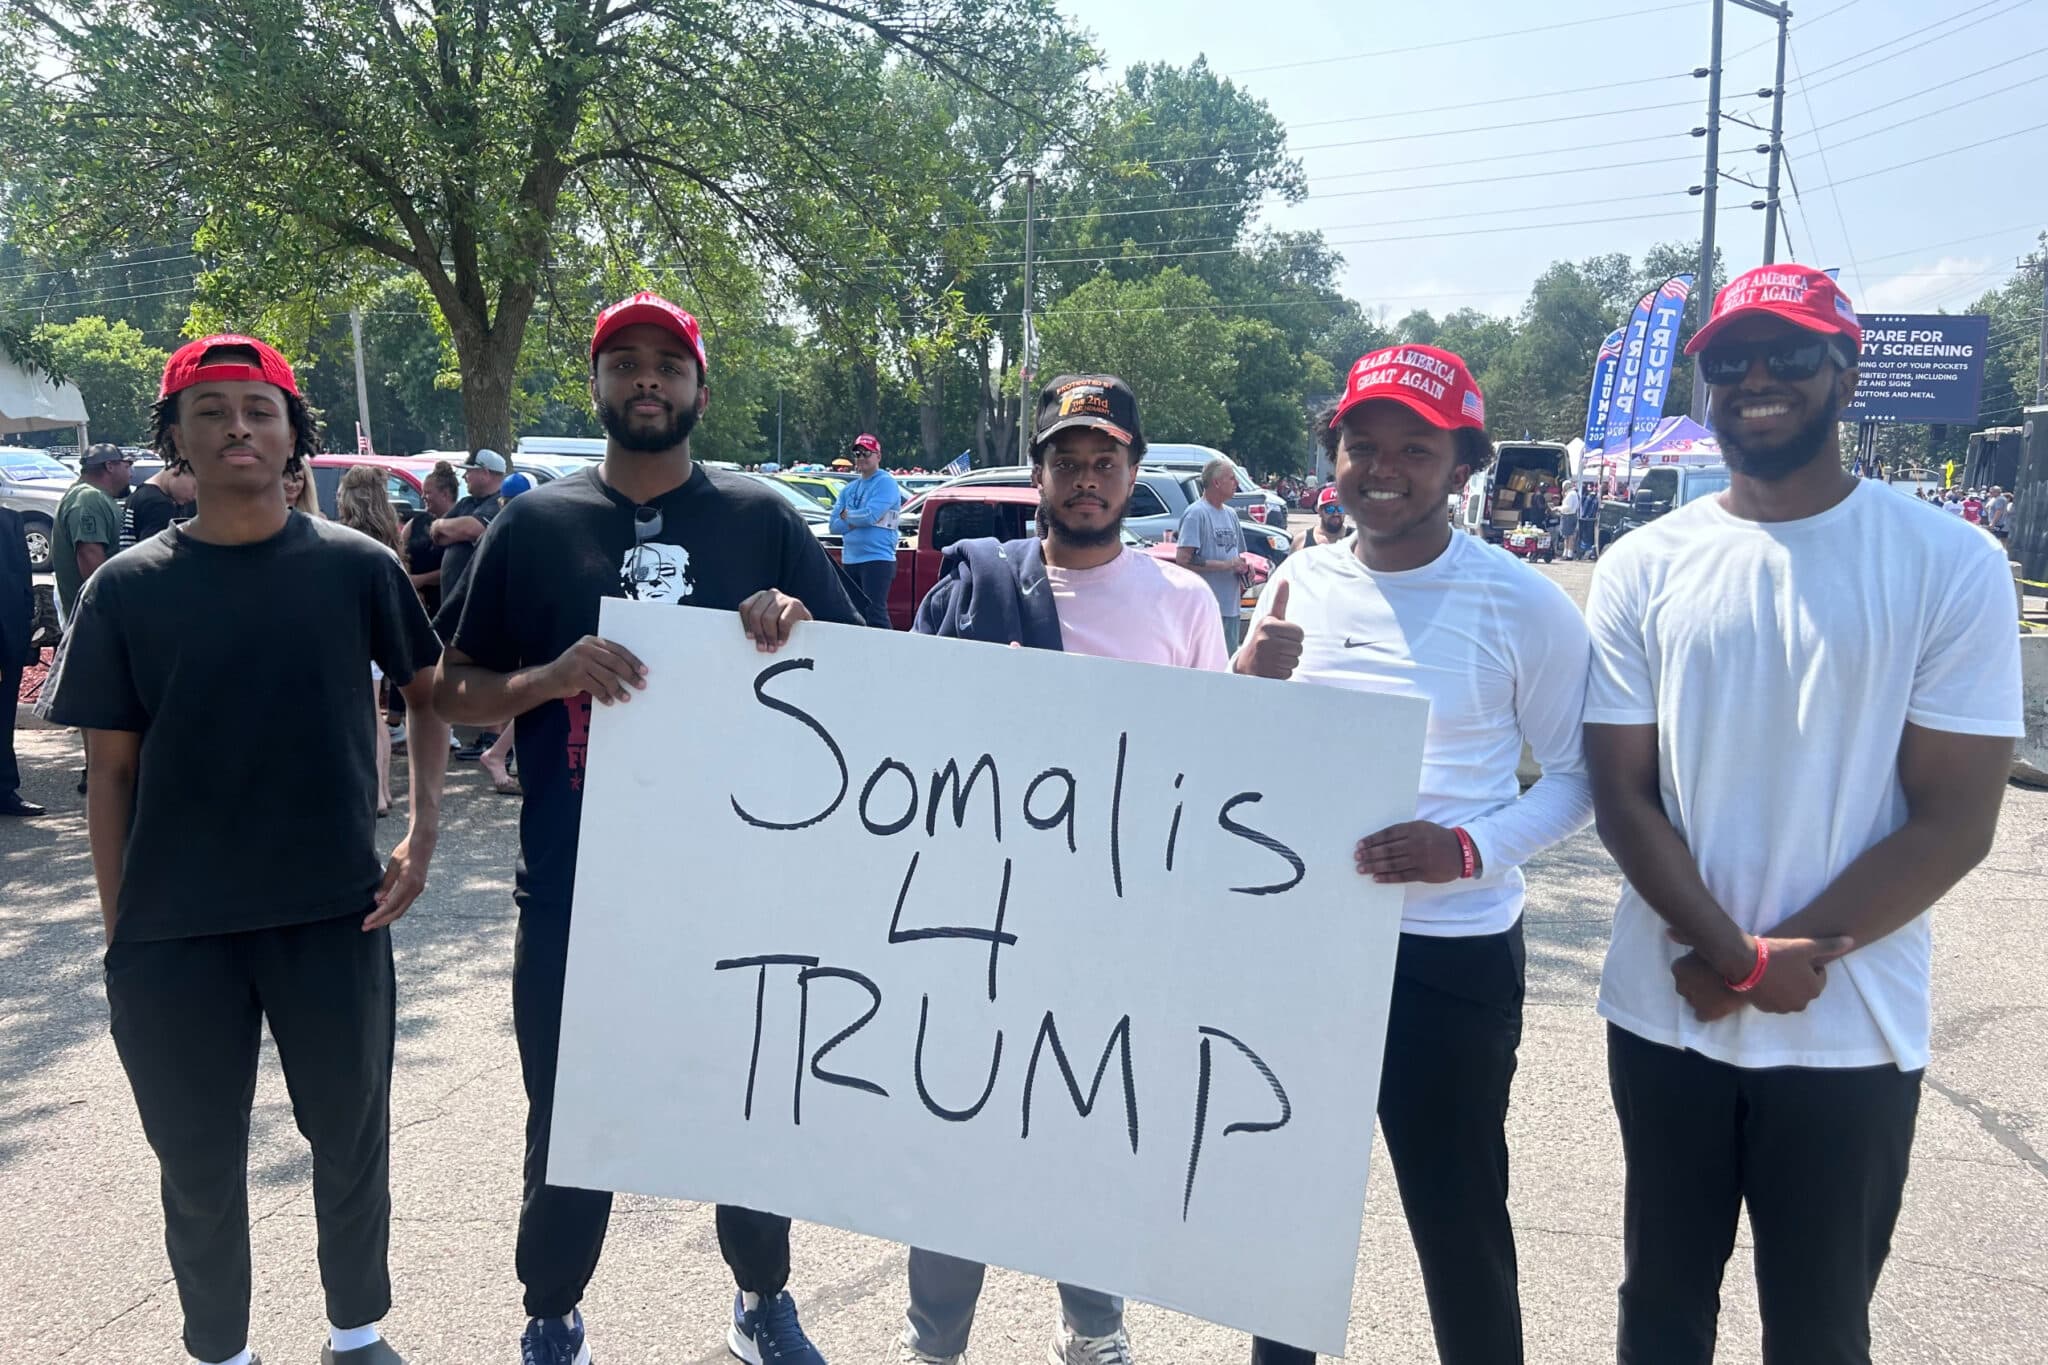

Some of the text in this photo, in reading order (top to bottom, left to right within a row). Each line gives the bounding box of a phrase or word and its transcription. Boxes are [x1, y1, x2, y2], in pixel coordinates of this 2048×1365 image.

[1750, 271, 1808, 290] AMERICA
[1760, 286, 1804, 302] AGAIN
[1861, 330, 1943, 342] EPARE FOR
[1860, 344, 1973, 357] TY SCREENING
[1355, 349, 1456, 386] MAKE AMERICA
[1056, 379, 1102, 395] PROTECTED
[1357, 368, 1445, 400] GREAT AGAIN
[1596, 360, 1617, 426] TRUMP
[1910, 391, 1936, 399] METAL
[1088, 395, 1108, 409] 2nd
[1589, 432, 1605, 441] 202
[731, 658, 1306, 897] Somalis
[889, 852, 1018, 1002] 4
[715, 954, 1292, 1221] TRUMP
